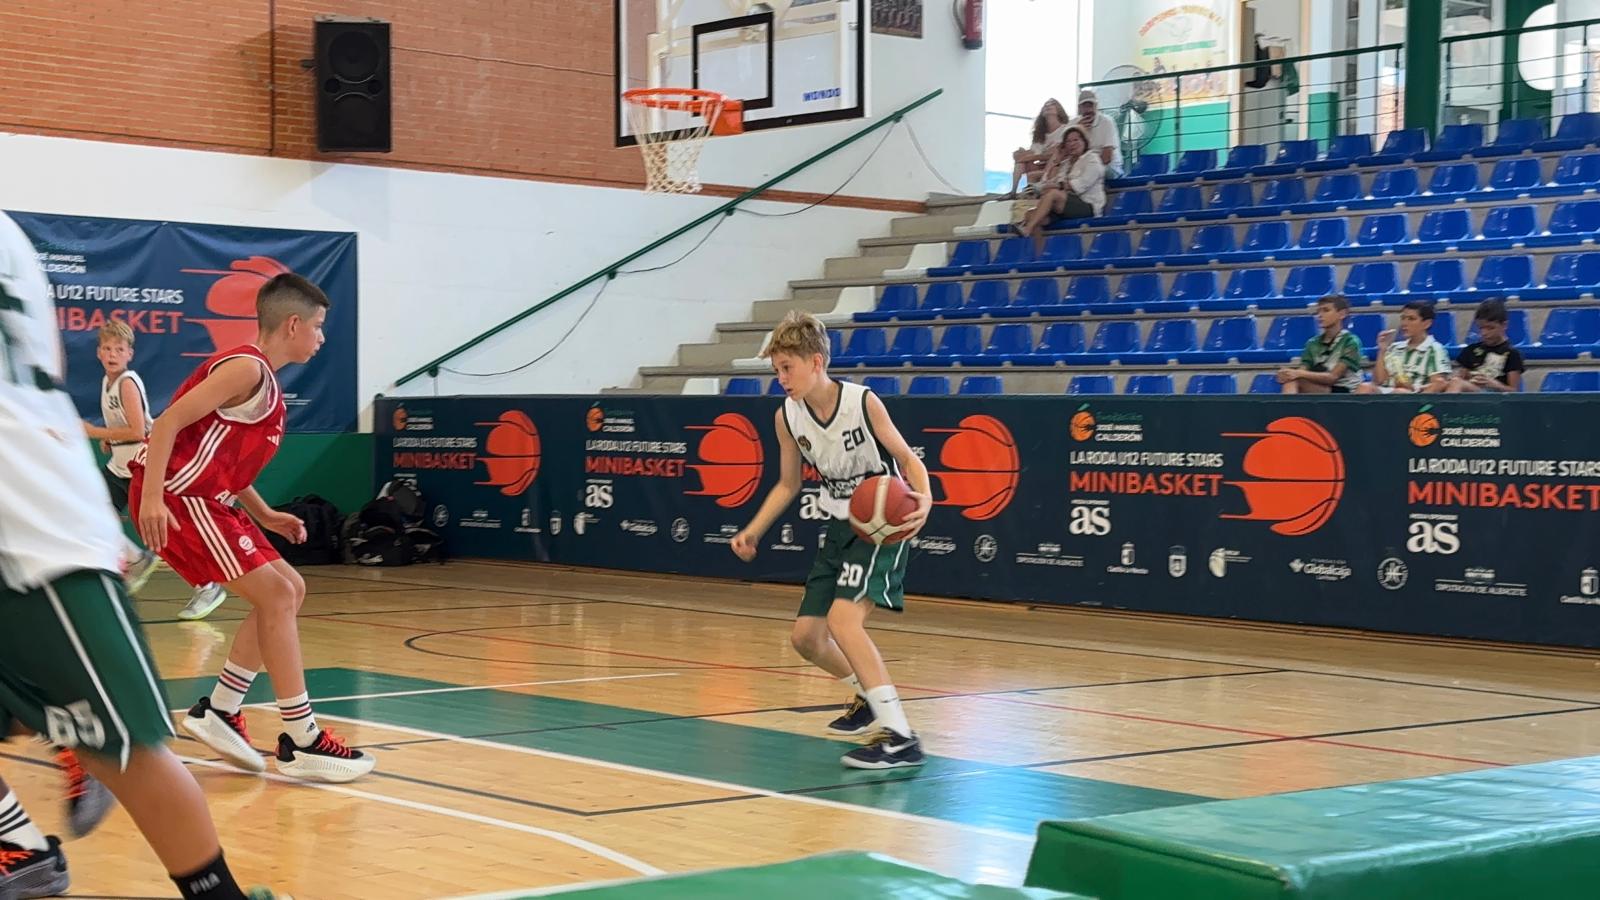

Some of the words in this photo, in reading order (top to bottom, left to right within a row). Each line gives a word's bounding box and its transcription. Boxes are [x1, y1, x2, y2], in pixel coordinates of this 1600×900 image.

[38, 263, 87, 275] ALDERÓN
[57, 284, 83, 300] U12
[85, 285, 140, 302] FUTURE
[141, 288, 184, 304] STARS
[842, 427, 865, 452] 20
[585, 456, 686, 477] MINIBASKET
[1070, 451, 1084, 465] LA
[1085, 452, 1117, 466] RODA
[1118, 453, 1139, 466] U12
[1141, 452, 1186, 467] FUTURE
[1187, 453, 1224, 468] STARS
[1408, 458, 1429, 473] LA
[1429, 458, 1469, 475] RODA
[1470, 459, 1496, 475] U12
[1498, 459, 1557, 476] FUTURE
[585, 484, 613, 508] as
[1069, 471, 1224, 497] MINIBASKET
[1407, 480, 1600, 511] MINIBASKET
[1069, 506, 1111, 536] as
[1407, 521, 1460, 554] as
[836, 561, 863, 587] 20
